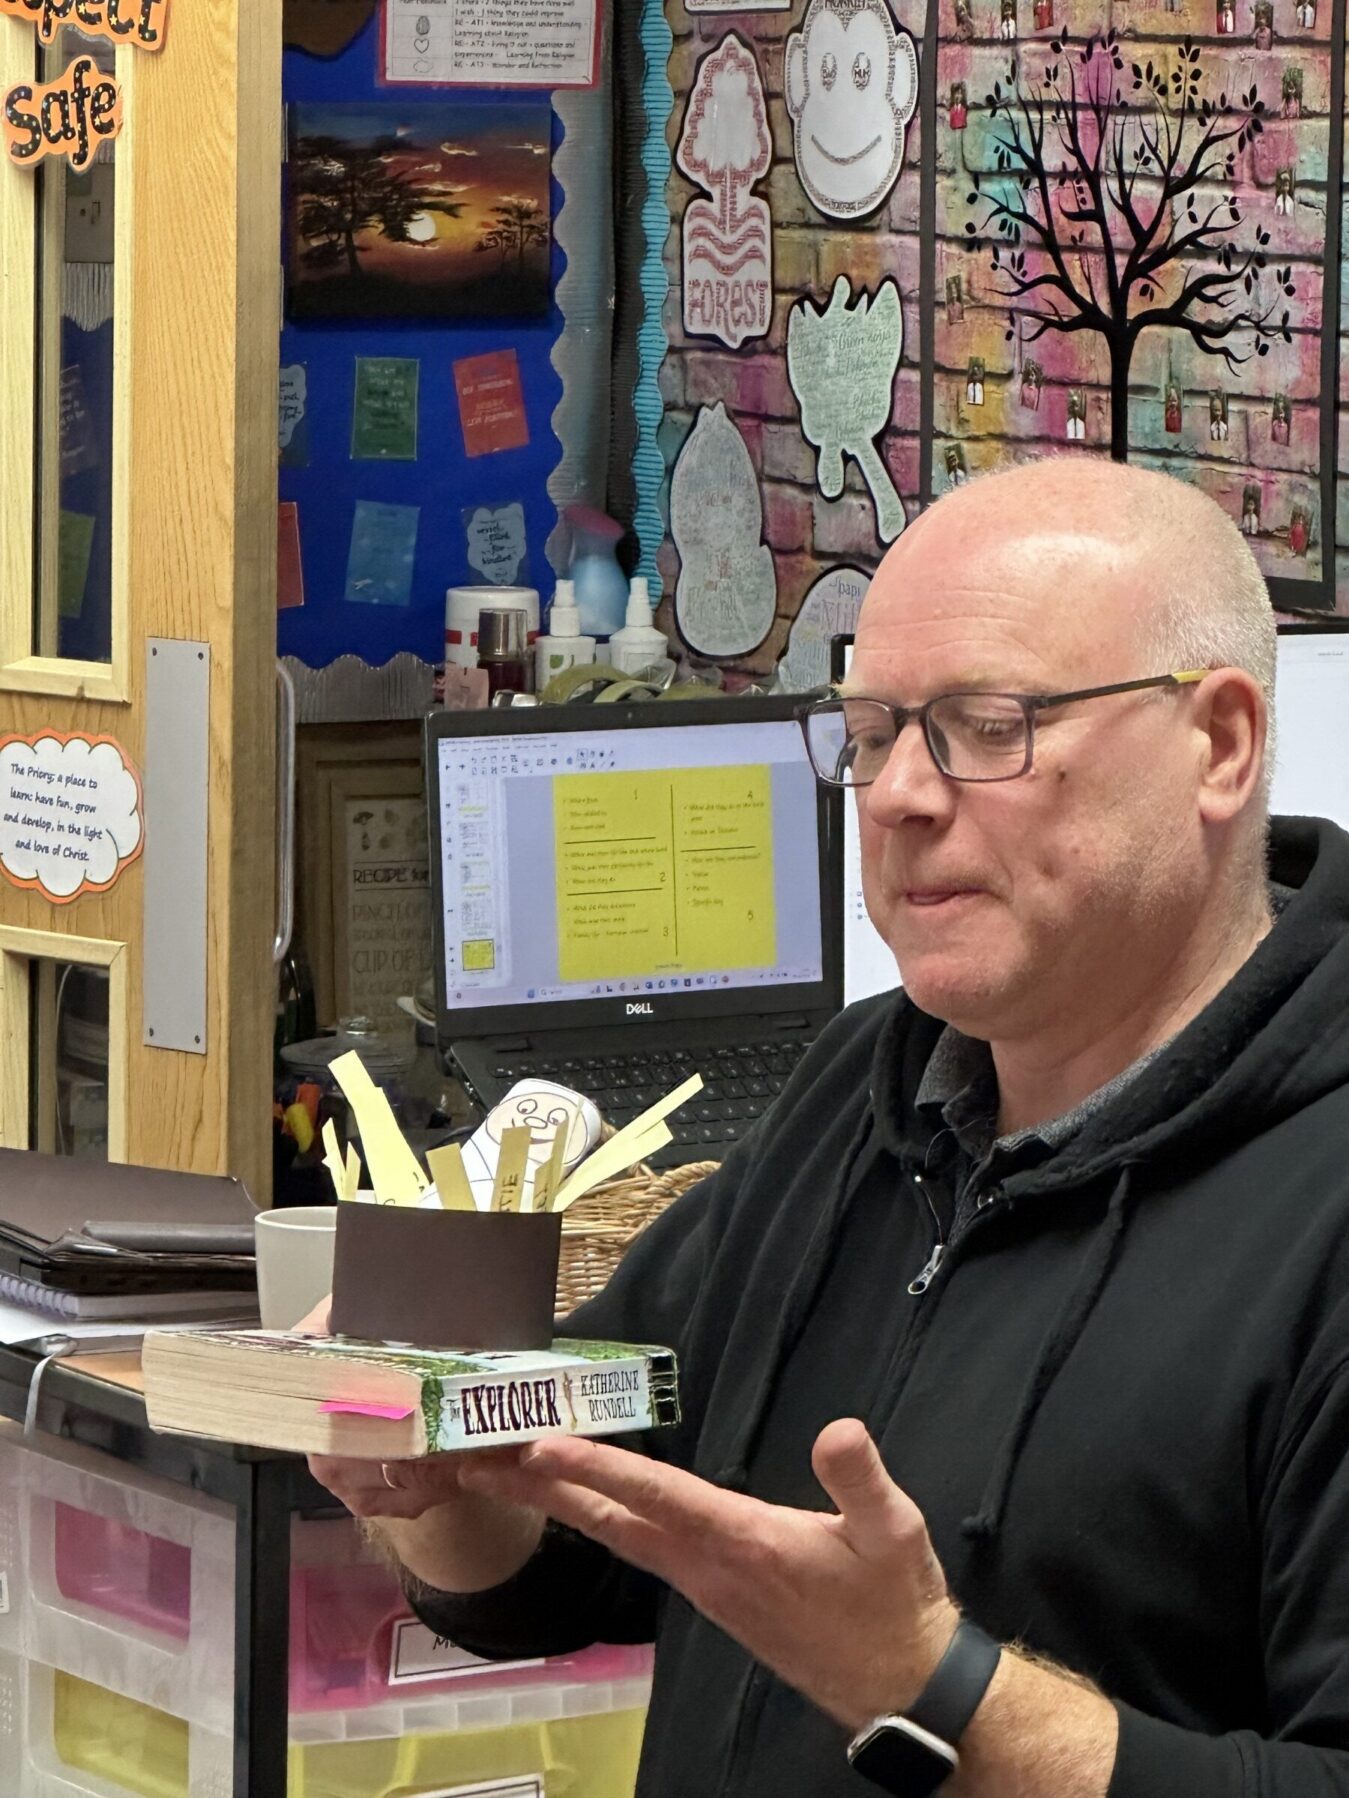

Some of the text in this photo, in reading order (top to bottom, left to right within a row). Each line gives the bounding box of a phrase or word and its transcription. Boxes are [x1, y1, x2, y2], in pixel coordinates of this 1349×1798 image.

[11, 763, 24, 776] The
[57, 775, 62, 783] a
[65, 774, 86, 788] place
[88, 779, 98, 789] to
[35, 792, 54, 806] have
[75, 804, 97, 814] grow
[3, 812, 19, 824] and
[56, 820, 65, 832] in
[68, 823, 82, 836] the
[84, 825, 103, 841] light
[15, 839, 31, 851] and
[34, 840, 49, 855] love
[52, 844, 61, 856] of
[659, 871, 667, 882] 2
[626, 1003, 653, 1015] DELL
[580, 1369, 639, 1397] KATHERINE
[461, 1378, 561, 1436] EXPLORER
[588, 1396, 637, 1422] RUNDELL
